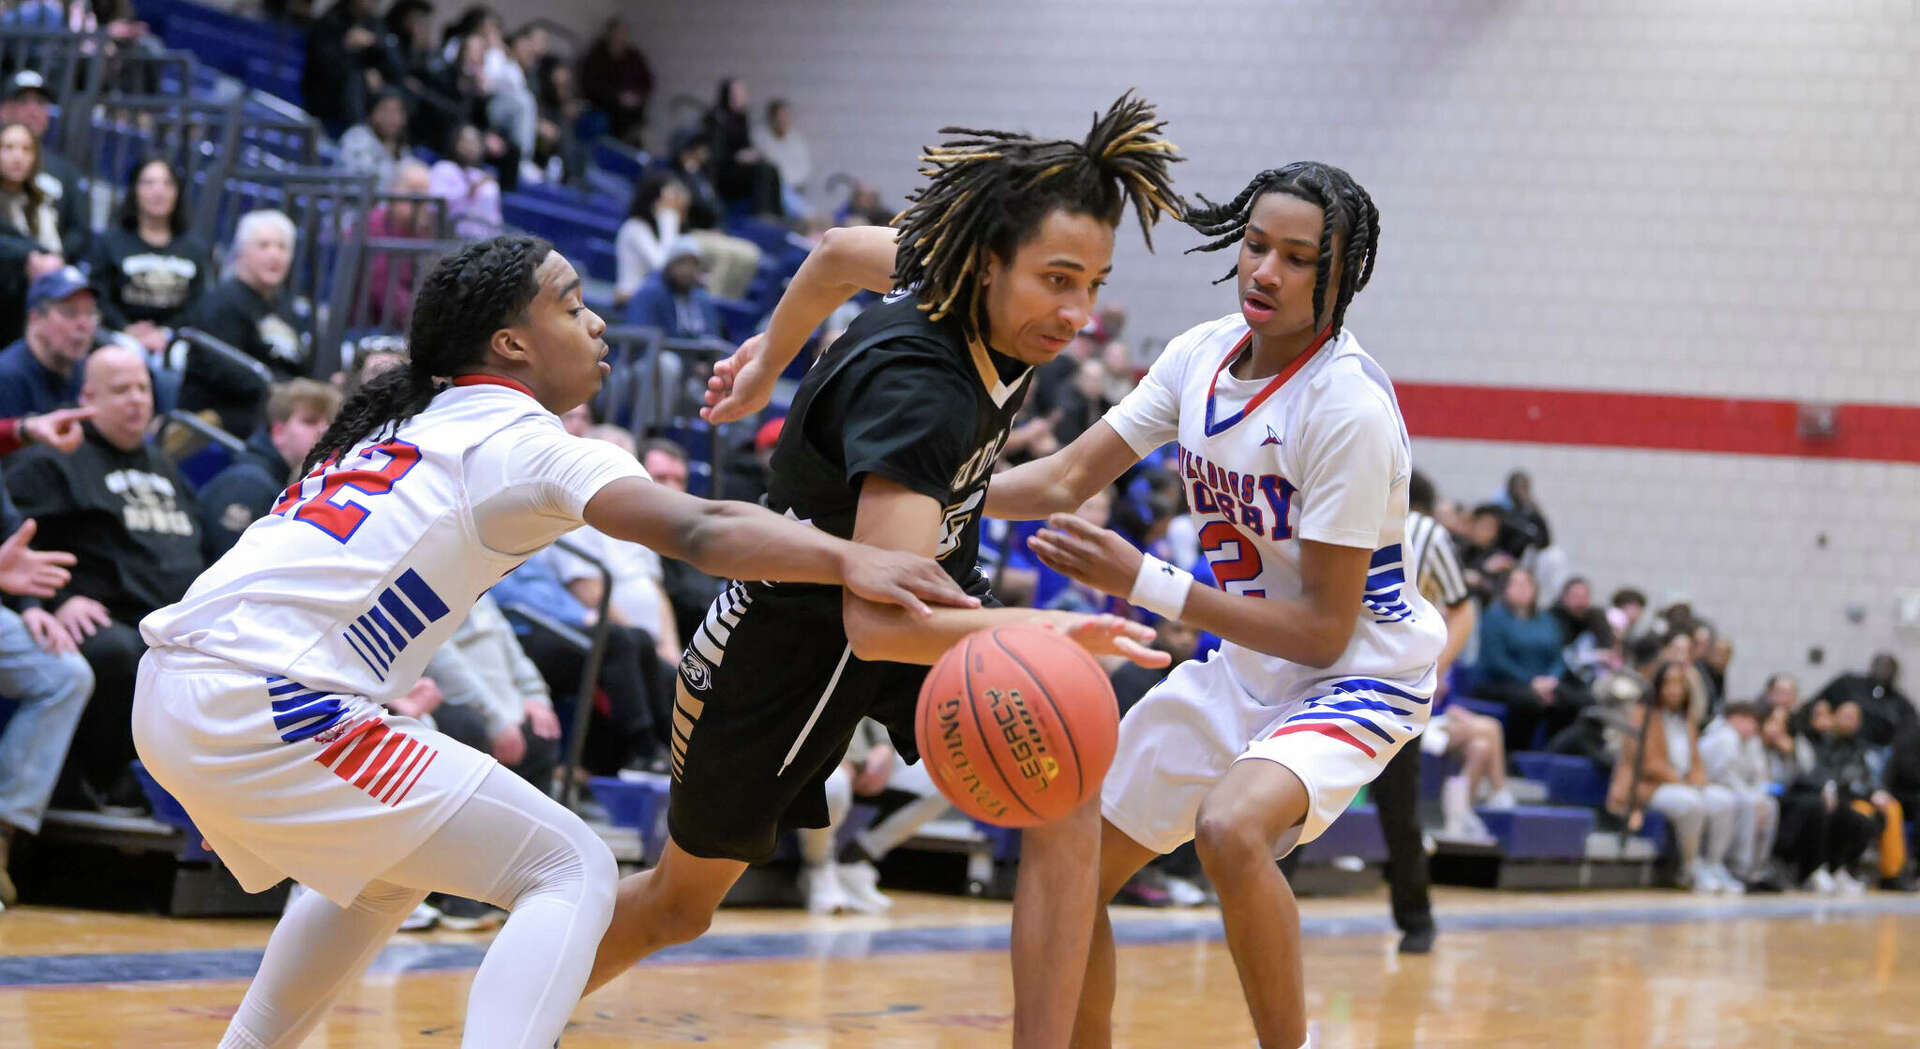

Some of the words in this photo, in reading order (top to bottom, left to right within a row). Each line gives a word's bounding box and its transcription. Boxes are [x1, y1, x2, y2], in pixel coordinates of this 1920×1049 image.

[270, 437, 422, 545] 12
[1178, 443, 1255, 504] ULLDOGS
[1198, 520, 1267, 599] 2
[937, 698, 1009, 818] SPALDING
[984, 688, 1048, 793] LEGACY
[1008, 687, 1046, 754] 1000
